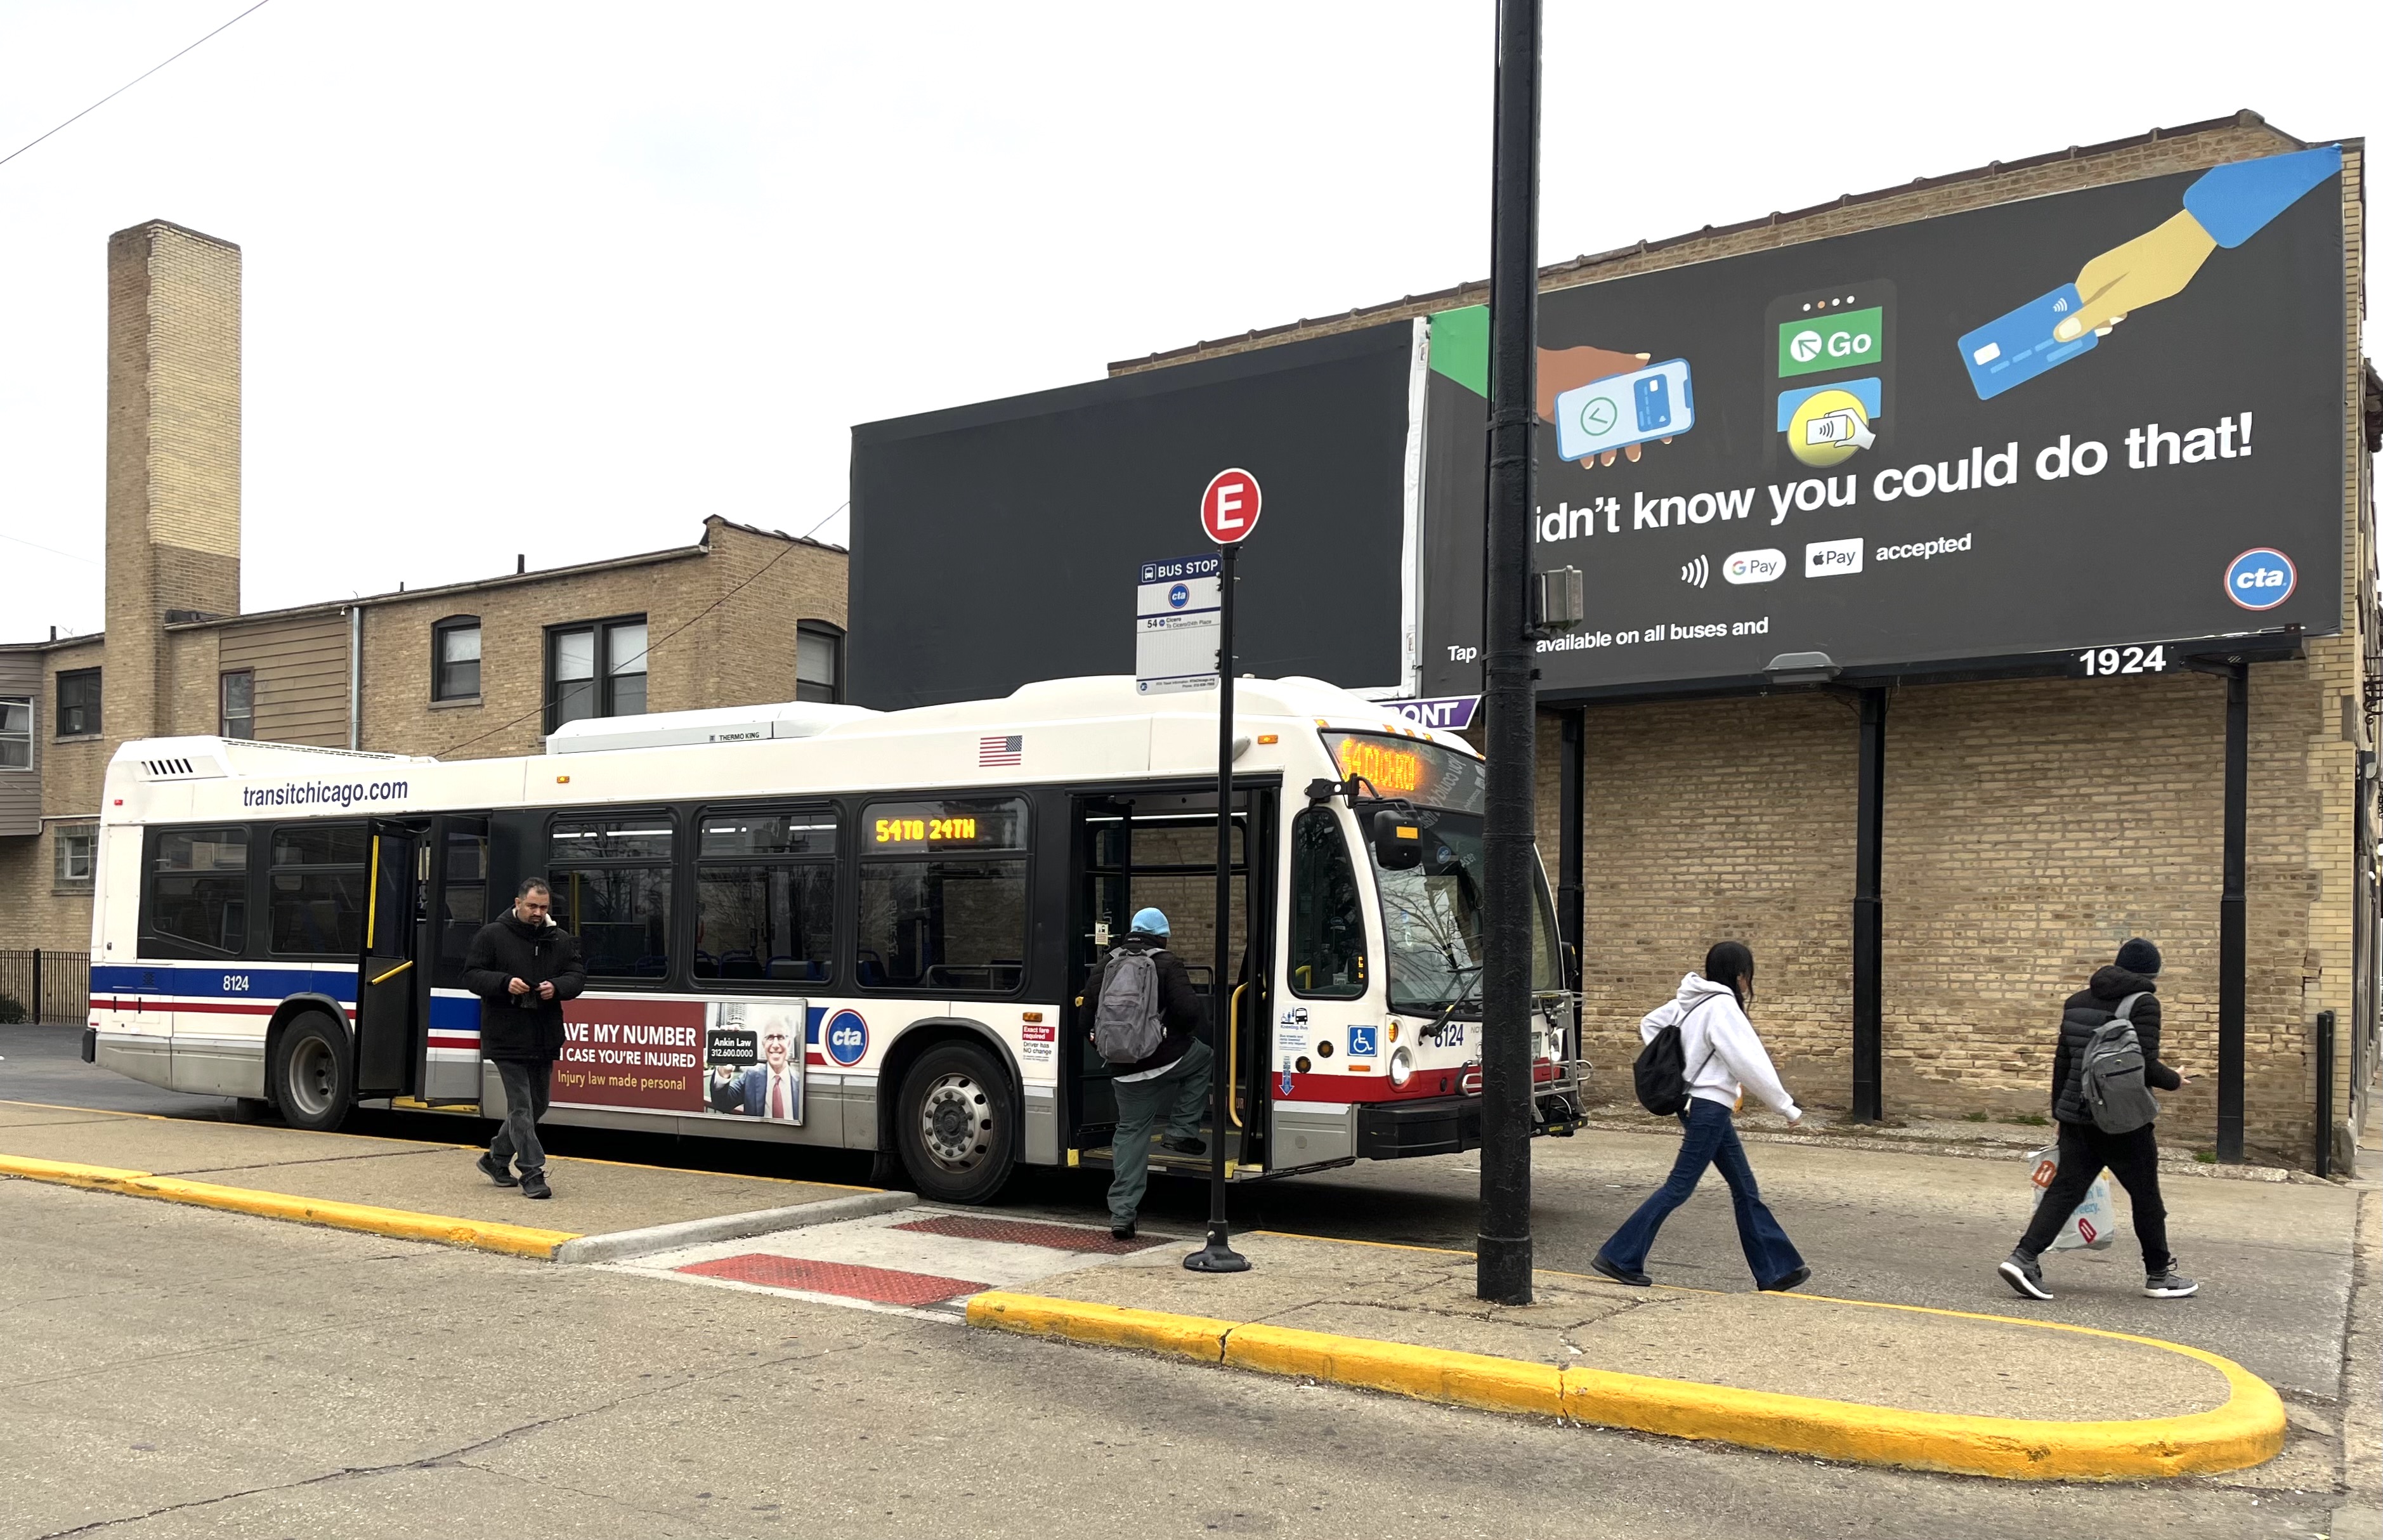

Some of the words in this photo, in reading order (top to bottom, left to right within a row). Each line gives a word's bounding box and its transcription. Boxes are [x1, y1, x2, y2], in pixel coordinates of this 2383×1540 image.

[1827, 331, 1872, 357] Go
[1536, 497, 1620, 543] idn't
[1634, 488, 1755, 530] know
[1768, 474, 1857, 526] you
[1873, 441, 2018, 502] could
[2035, 434, 2108, 480] do
[2125, 412, 2252, 469] that!
[1217, 483, 1244, 530] E
[1827, 551, 1855, 565] Pay
[1876, 533, 1972, 561] accepted
[1158, 564, 1182, 578] BUS
[1186, 559, 1218, 574] STOP
[2236, 568, 2283, 589] cta
[1172, 591, 1186, 601] cta
[1147, 619, 1158, 628] 54
[1447, 644, 1477, 663] Tap
[1536, 630, 1612, 653] available
[1616, 630, 1639, 646] on
[1644, 625, 1665, 642] all
[1670, 621, 1727, 640] buses
[1732, 617, 1768, 636] and
[2080, 645, 2166, 676] 1924
[243, 781, 408, 807] transitchicago.com
[929, 819, 975, 839] 24TH
[223, 975, 249, 991] 8124
[594, 1024, 620, 1043] MY
[623, 1026, 696, 1047] NUMBER
[714, 1037, 734, 1047] Ankin
[736, 1038, 752, 1047] Law
[832, 1028, 861, 1046] cta
[566, 1048, 596, 1062] CASE
[597, 1049, 641, 1065] YOU'RE
[644, 1052, 696, 1067] INJURED
[711, 1048, 754, 1057] 312.600.0000
[558, 1069, 585, 1087] Injury
[588, 1071, 606, 1085] law
[609, 1073, 637, 1087] made
[641, 1076, 686, 1092] personal
